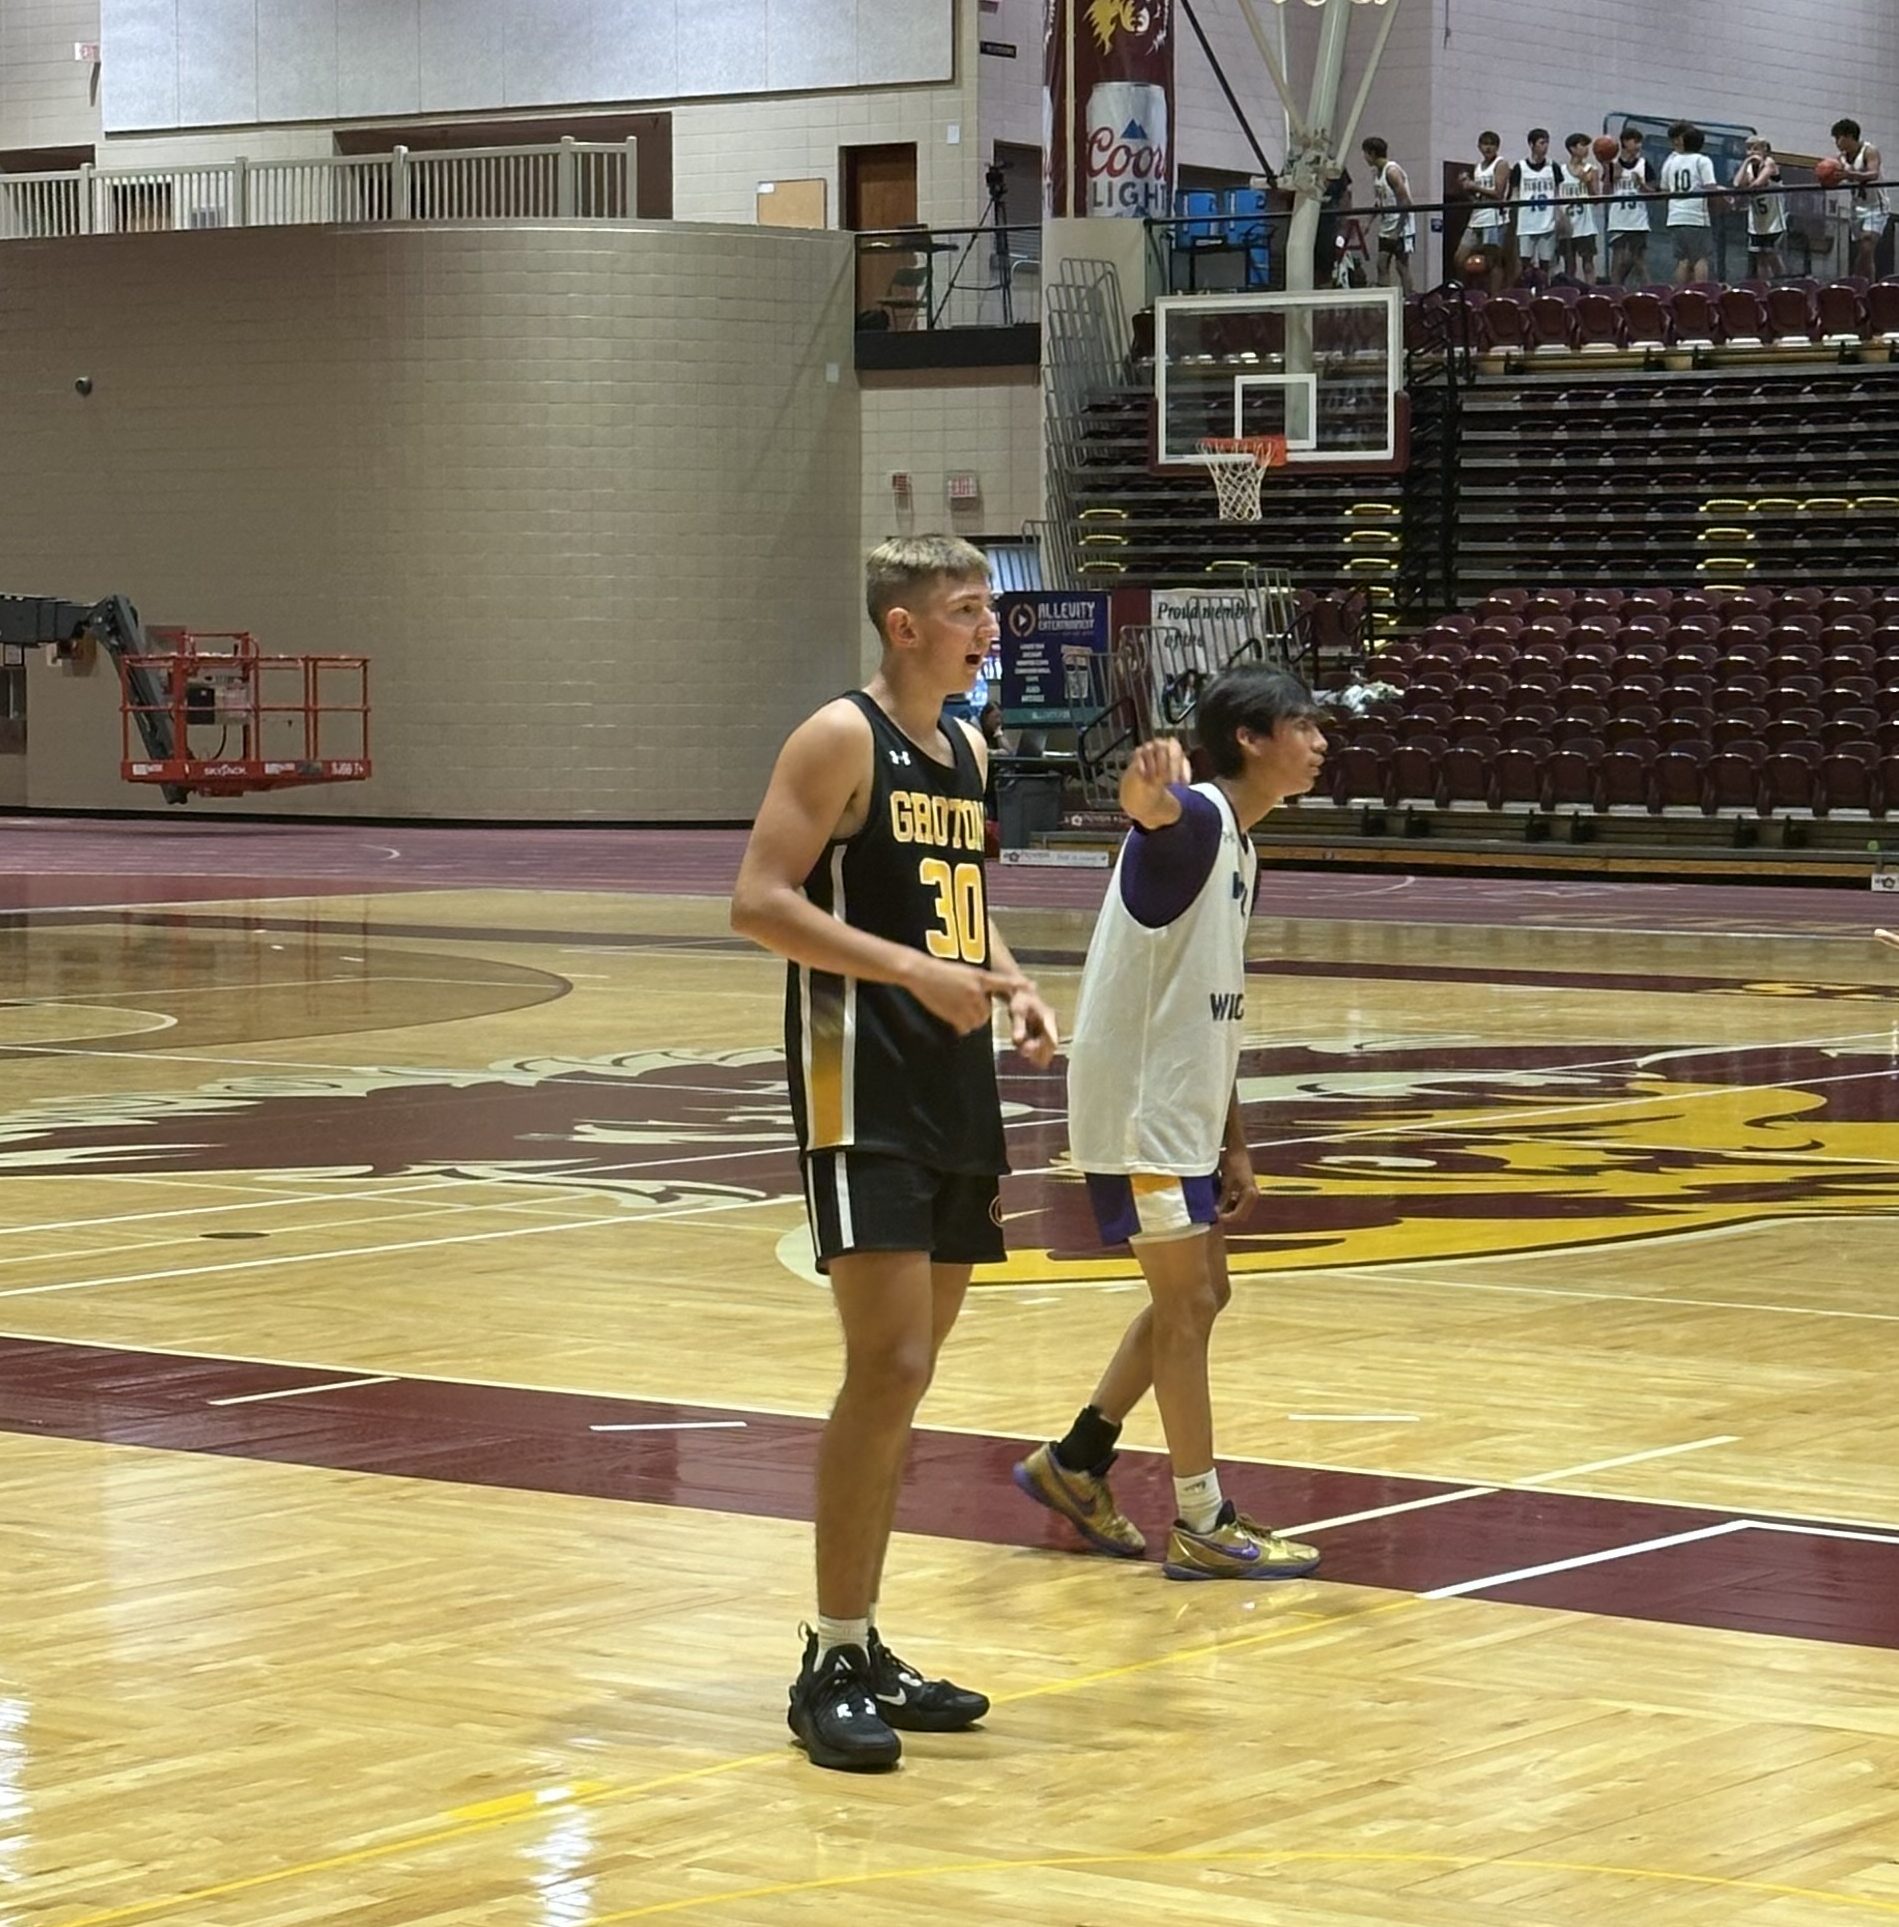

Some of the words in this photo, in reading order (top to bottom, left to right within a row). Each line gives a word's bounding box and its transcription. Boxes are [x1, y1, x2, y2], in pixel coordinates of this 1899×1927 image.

[1674, 168, 1690, 192] 10
[1093, 181, 1167, 208] LIGHT
[1038, 602, 1095, 619] ALLEVITY
[1157, 601, 1198, 620] Proud
[889, 790, 985, 852] GROTON
[918, 857, 986, 964] 30
